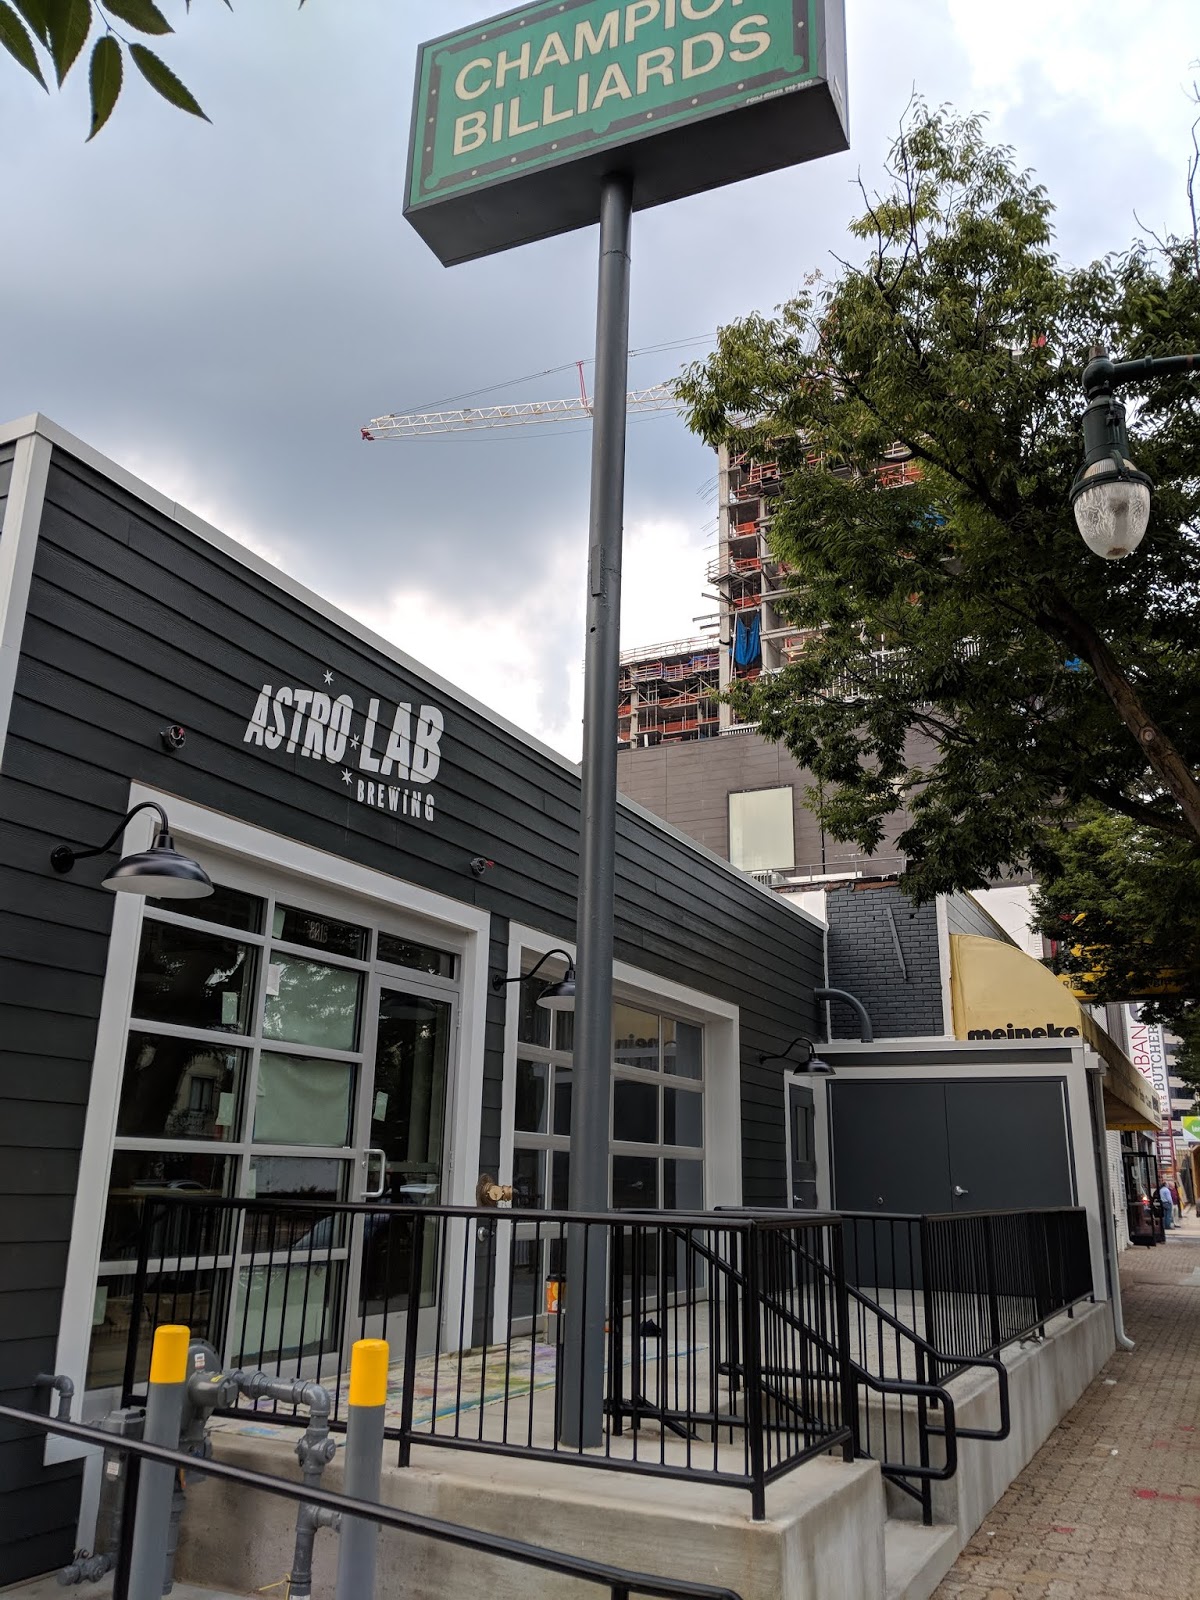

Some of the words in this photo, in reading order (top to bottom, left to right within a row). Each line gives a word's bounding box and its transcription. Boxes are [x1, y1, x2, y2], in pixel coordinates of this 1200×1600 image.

[453, 0, 744, 101] CHAMPI
[453, 14, 771, 156] BILLIARDS
[243, 684, 354, 764] ASTRO
[359, 698, 444, 784] LAB
[357, 780, 435, 822] BREWING
[967, 1023, 1079, 1040] meineke
[1130, 1025, 1152, 1080] RBAN
[1148, 1023, 1165, 1091] BUTCHER
